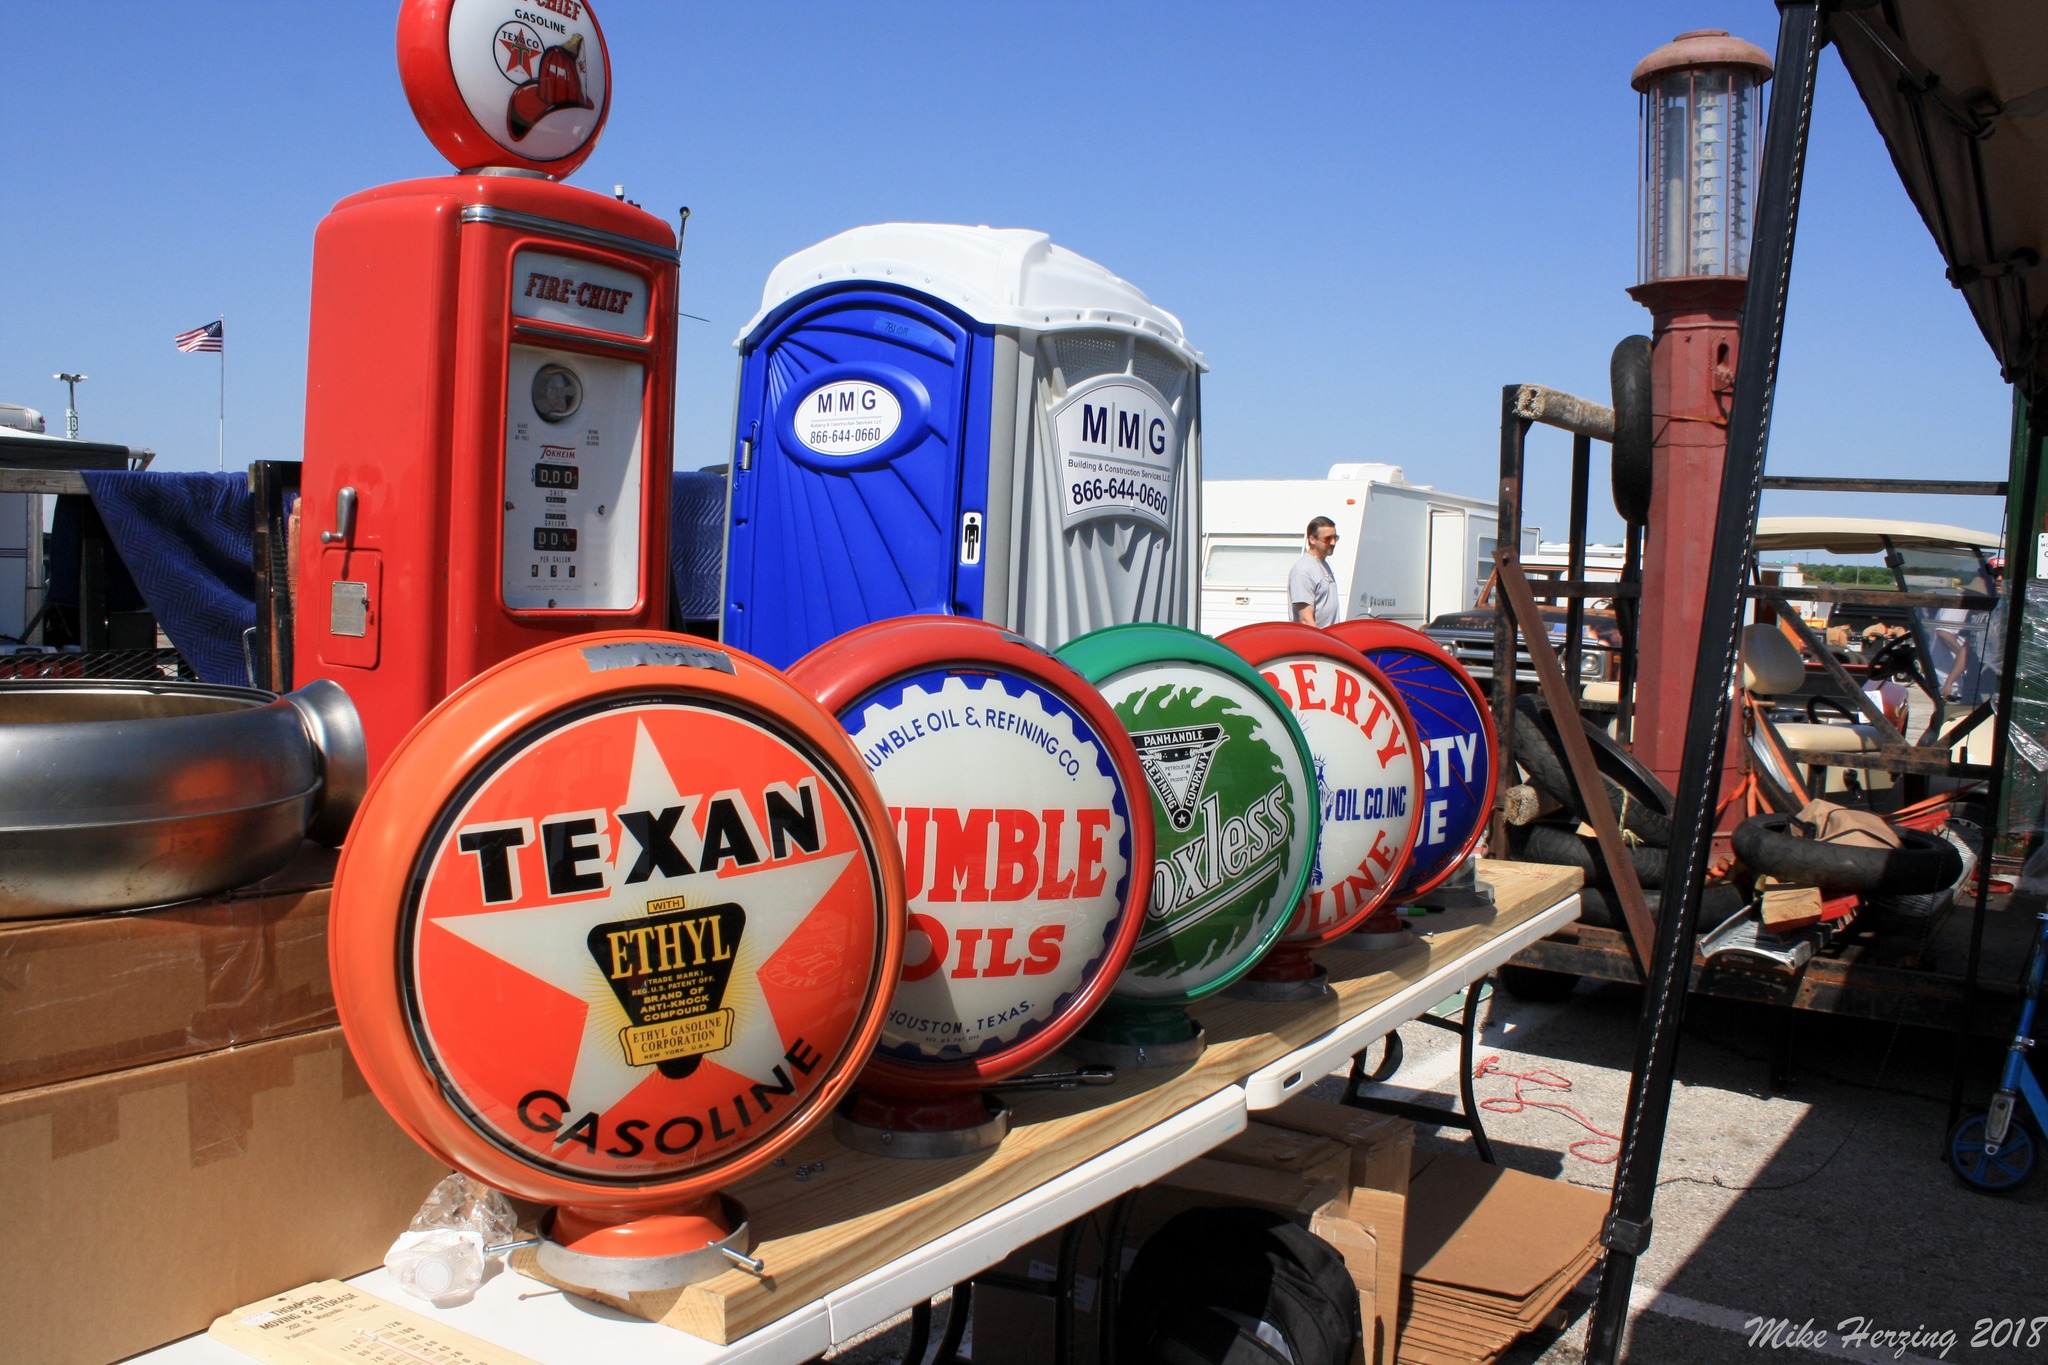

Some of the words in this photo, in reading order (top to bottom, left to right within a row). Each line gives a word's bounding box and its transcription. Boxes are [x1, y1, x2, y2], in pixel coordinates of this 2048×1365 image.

[514, 8, 566, 35] GASOLINE
[502, 30, 540, 49] TEXACO
[1704, 146, 1713, 157] 4
[1703, 182, 1712, 192] 6
[1703, 218, 1712, 229] 8
[524, 272, 633, 315] FIRE-CHIEF
[810, 427, 881, 444] 866-644-0660
[540, 445, 576, 460] TOKHEIM
[1068, 458, 1097, 472] Building
[1098, 463, 1103, 471] &
[1104, 464, 1141, 478] Construction
[1141, 470, 1162, 480] Services
[1071, 477, 1168, 516] 866-644-0660
[864, 717, 927, 773] UMBLE
[926, 708, 960, 732] OIL
[965, 706, 981, 729] &
[985, 708, 1060, 756] REFINING
[1058, 749, 1081, 782] CO.
[1143, 730, 1205, 747] PANHANDLE
[1164, 763, 1191, 772] PETROLEUM
[1142, 759, 1178, 810] REFINING
[1185, 750, 1209, 808] COMPANY
[1335, 788, 1361, 822] OIL
[458, 781, 826, 905] TEXAN
[652, 900, 681, 912] WITH
[606, 914, 731, 980] ETHYL
[900, 913, 1066, 982] OILS
[643, 974, 673, 987] (TRADE
[676, 970, 704, 981] MARK)
[668, 979, 696, 991] PATENT
[639, 994, 710, 1014] ANTI-KNOCK
[643, 990, 683, 1005] BRAND
[689, 986, 705, 996] OF
[643, 1004, 708, 1022] COMPOUND
[976, 1000, 1035, 1031] TEXAS.
[633, 1027, 668, 1044] ETHYL
[670, 1017, 722, 1036] GASOLINE
[641, 1029, 715, 1053] CORPORATION
[644, 1052, 660, 1060] NEW
[516, 1037, 823, 1159] GASOLINE
[258, 1312, 301, 1331] MOVING
[312, 1292, 360, 1311] STORAGE
[269, 1294, 327, 1317] THOMPSON
[385, 1320, 402, 1329] 120
[398, 1326, 416, 1335] 100
